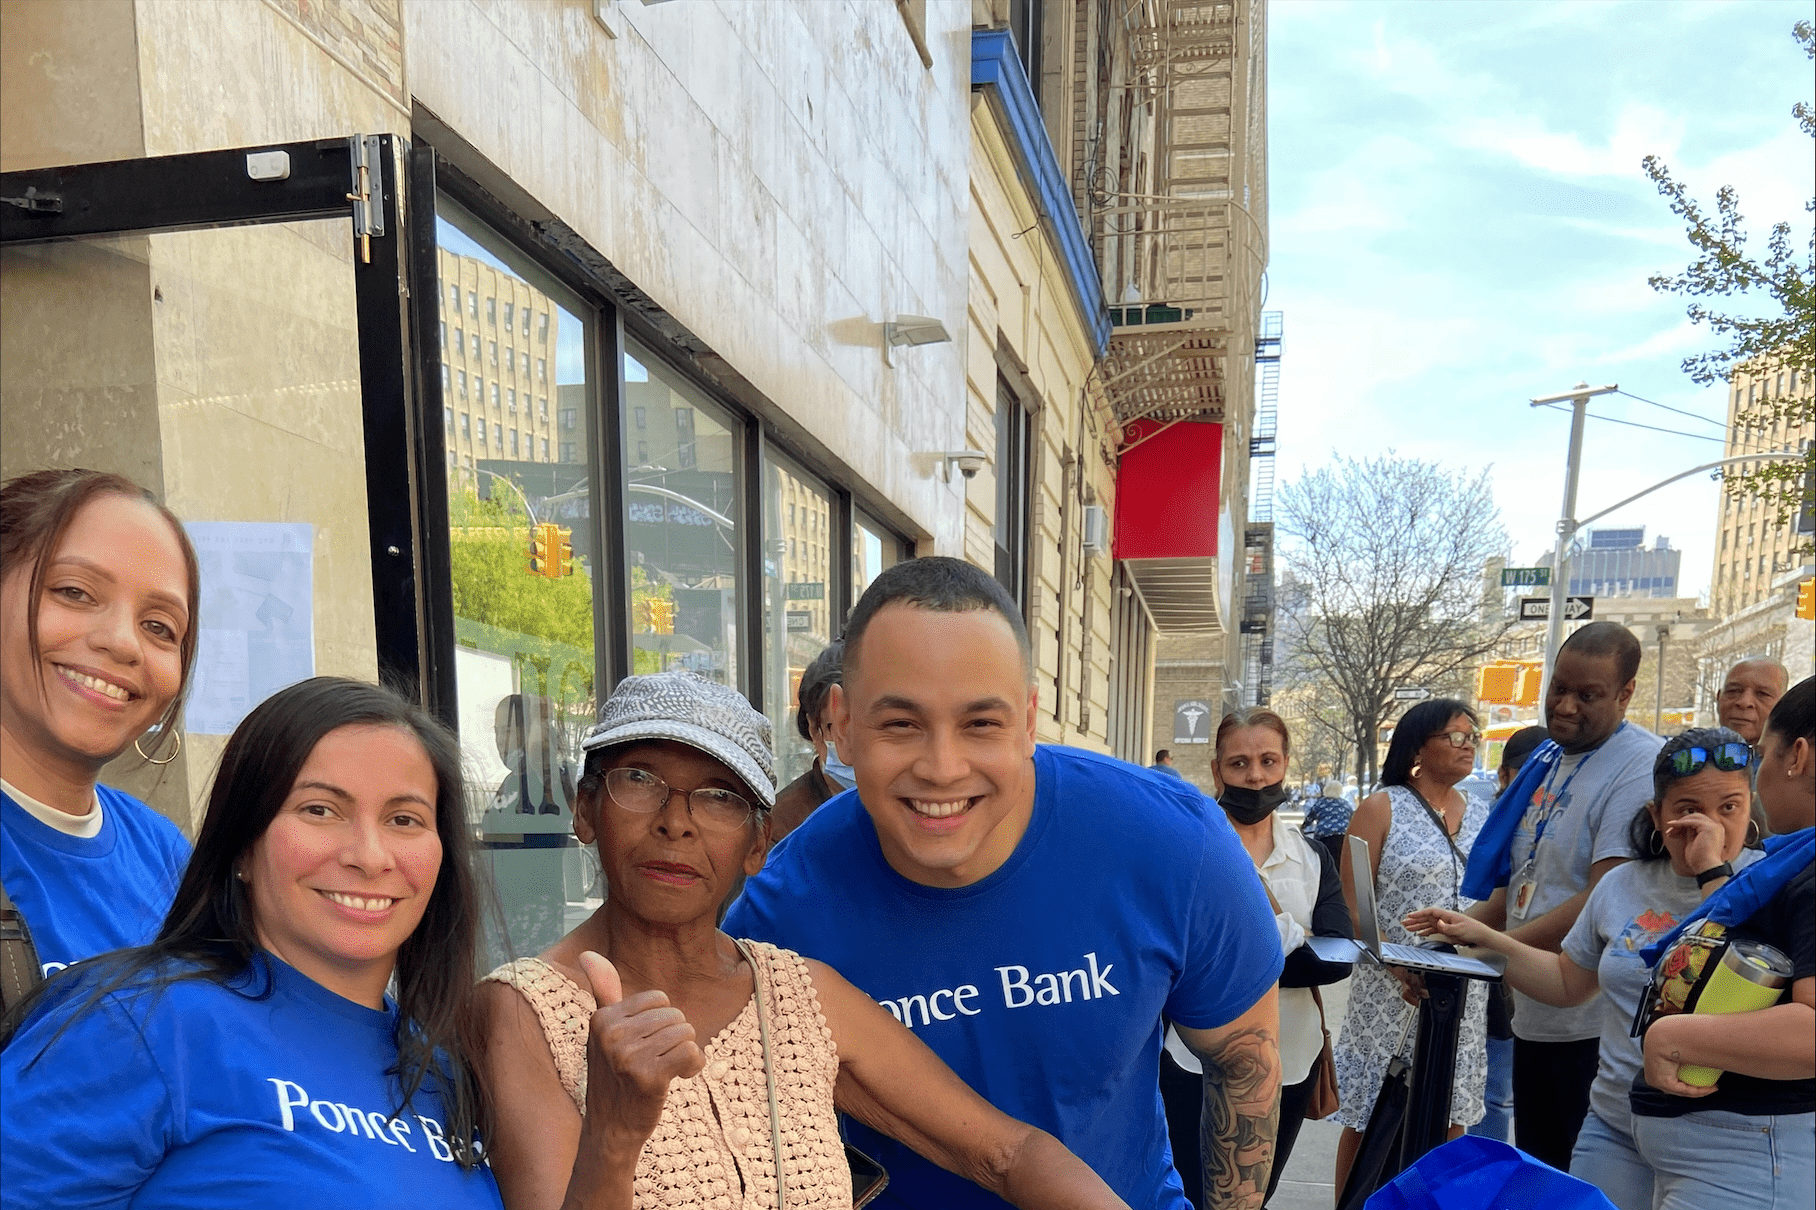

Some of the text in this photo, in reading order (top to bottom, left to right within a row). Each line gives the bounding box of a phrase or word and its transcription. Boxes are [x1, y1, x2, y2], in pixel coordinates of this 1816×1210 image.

[1505, 568, 1516, 585] W
[1519, 569, 1537, 585] 175
[866, 951, 1121, 1029] once Bank
[266, 1077, 417, 1154] Ponce
